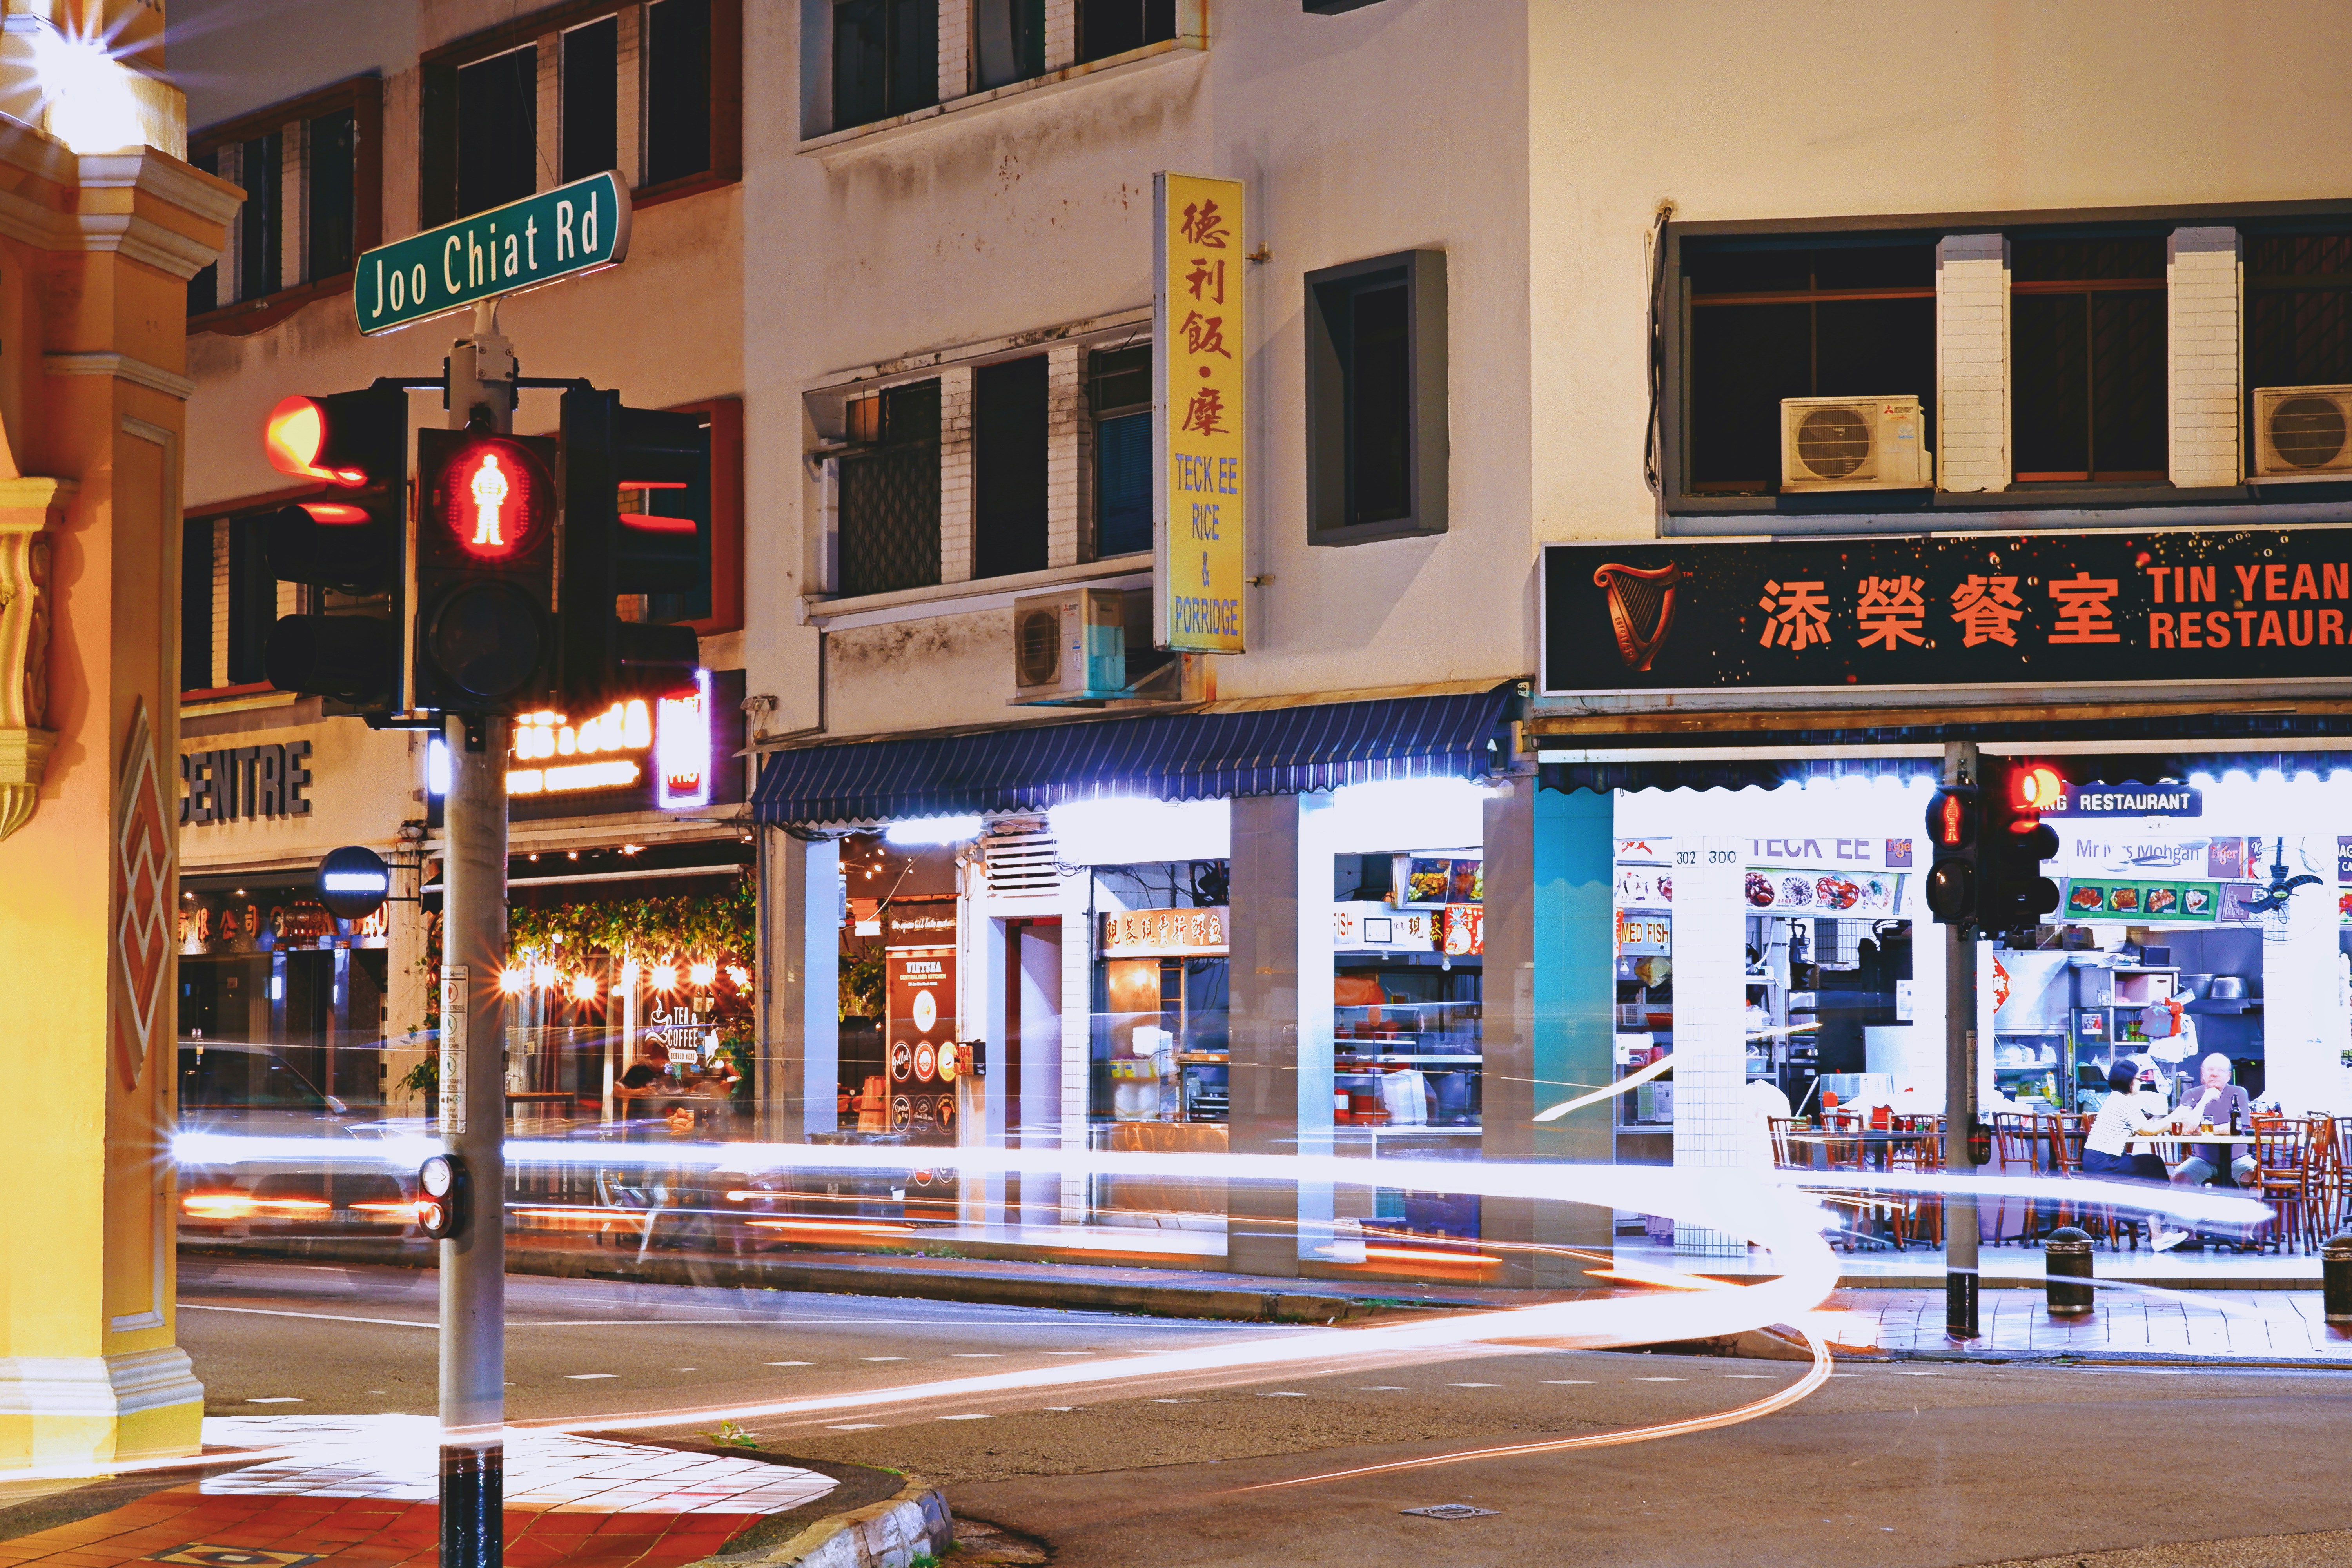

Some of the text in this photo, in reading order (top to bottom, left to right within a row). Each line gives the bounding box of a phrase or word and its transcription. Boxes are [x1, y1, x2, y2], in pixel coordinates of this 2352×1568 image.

[372, 191, 597, 318] Joo Chiat Rd
[1175, 453, 1238, 494] TECK EE
[1192, 503, 1220, 540] RICE
[1201, 551, 1210, 587] &
[2146, 563, 2350, 603] TIN YEAN
[1176, 596, 1238, 636] PORRIDGE
[1759, 572, 2121, 650] 添榮餐室
[2149, 609, 2352, 648] RESTAUR
[2080, 793, 2190, 811] RESTAURANT
[1677, 851, 1736, 864] 302 300
[2077, 839, 2099, 857] Mr
[1647, 922, 1669, 943] FISH
[906, 961, 942, 973] VIETSEA
[673, 1007, 698, 1026] TEA &
[668, 1028, 698, 1047] COFFEE
[956, 1046, 971, 1058] 304
[960, 1059, 966, 1071] A
